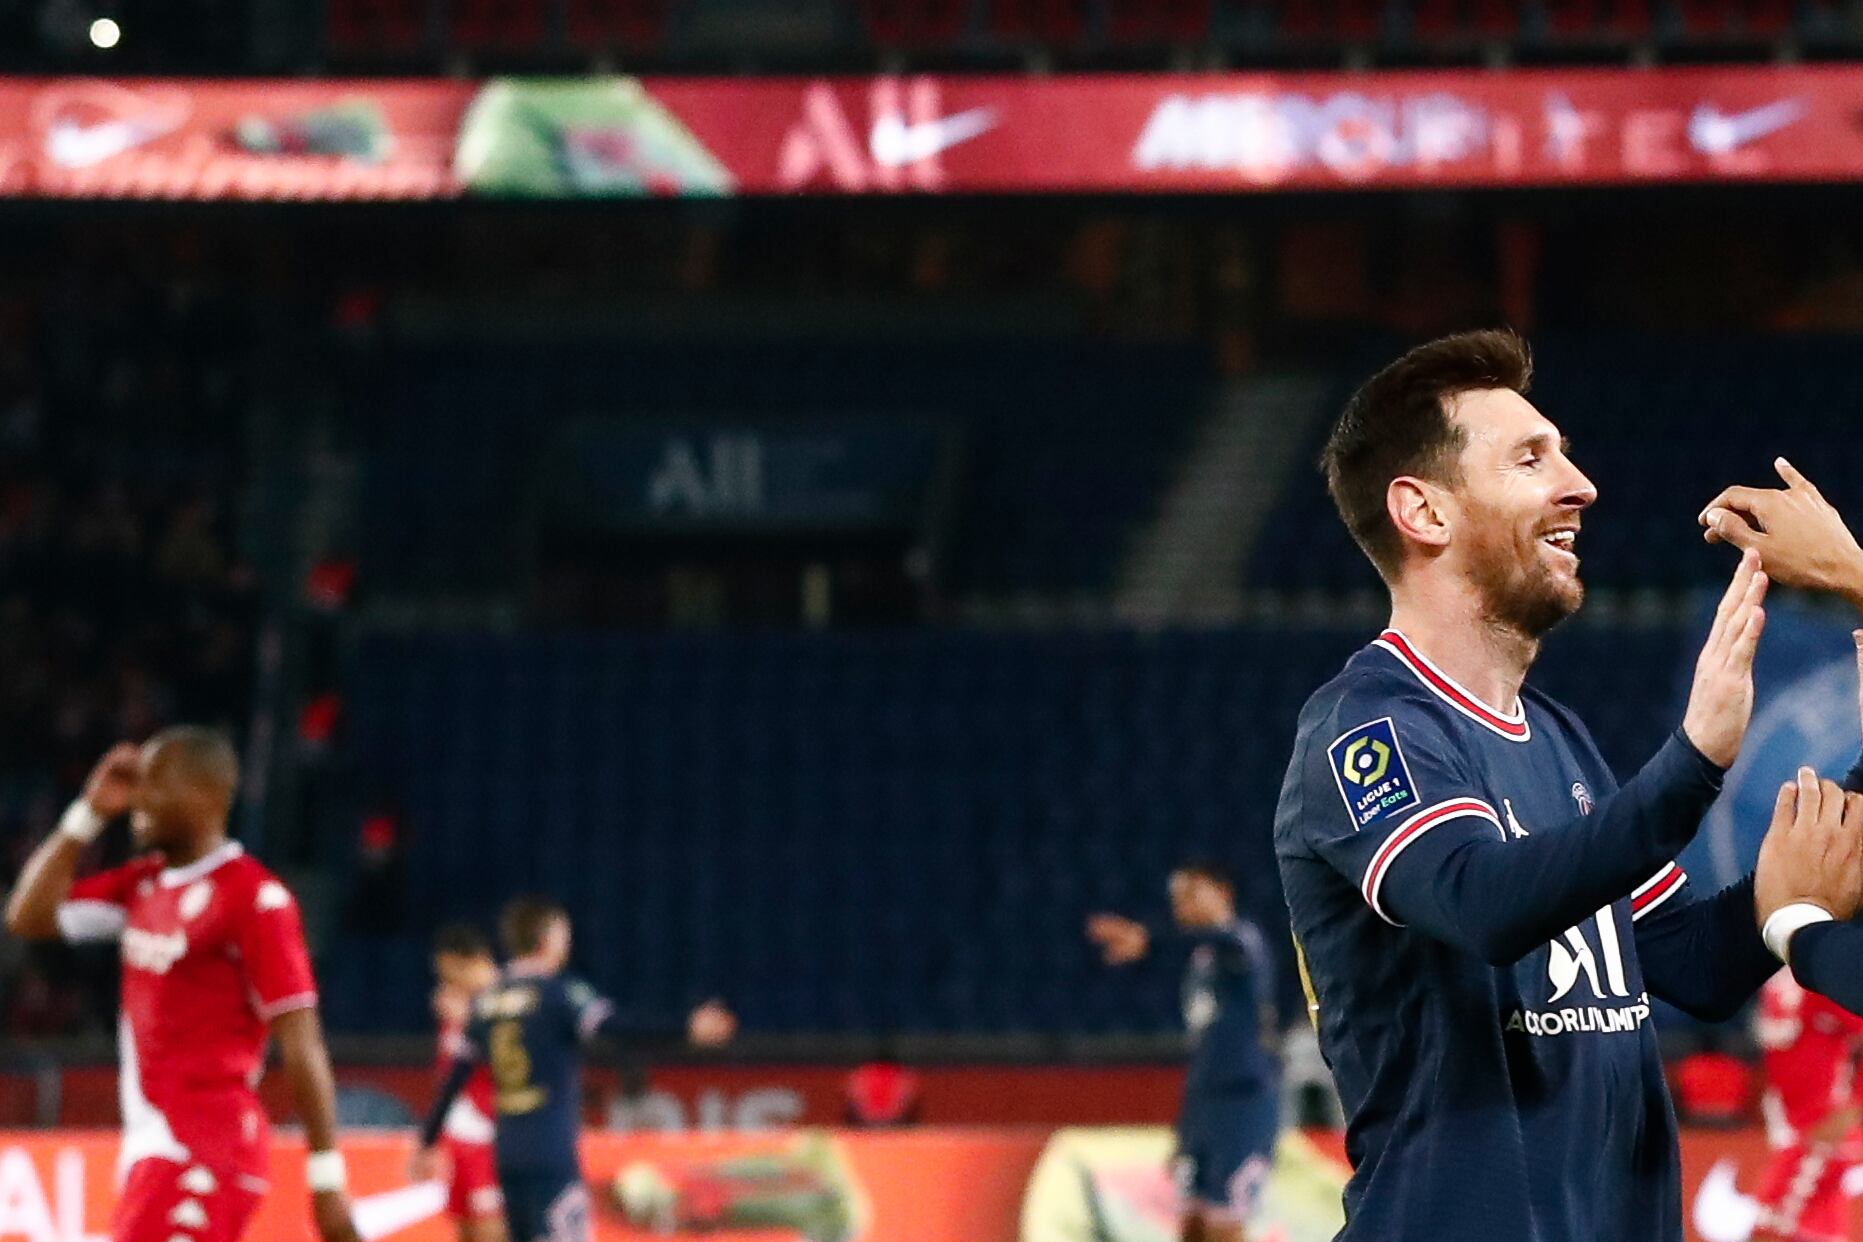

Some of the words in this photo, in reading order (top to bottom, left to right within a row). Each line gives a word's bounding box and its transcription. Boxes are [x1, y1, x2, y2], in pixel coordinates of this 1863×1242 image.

[1356, 781, 1392, 811] LIGUE
[1392, 777, 1401, 788] 1
[1380, 789, 1409, 808] Eats
